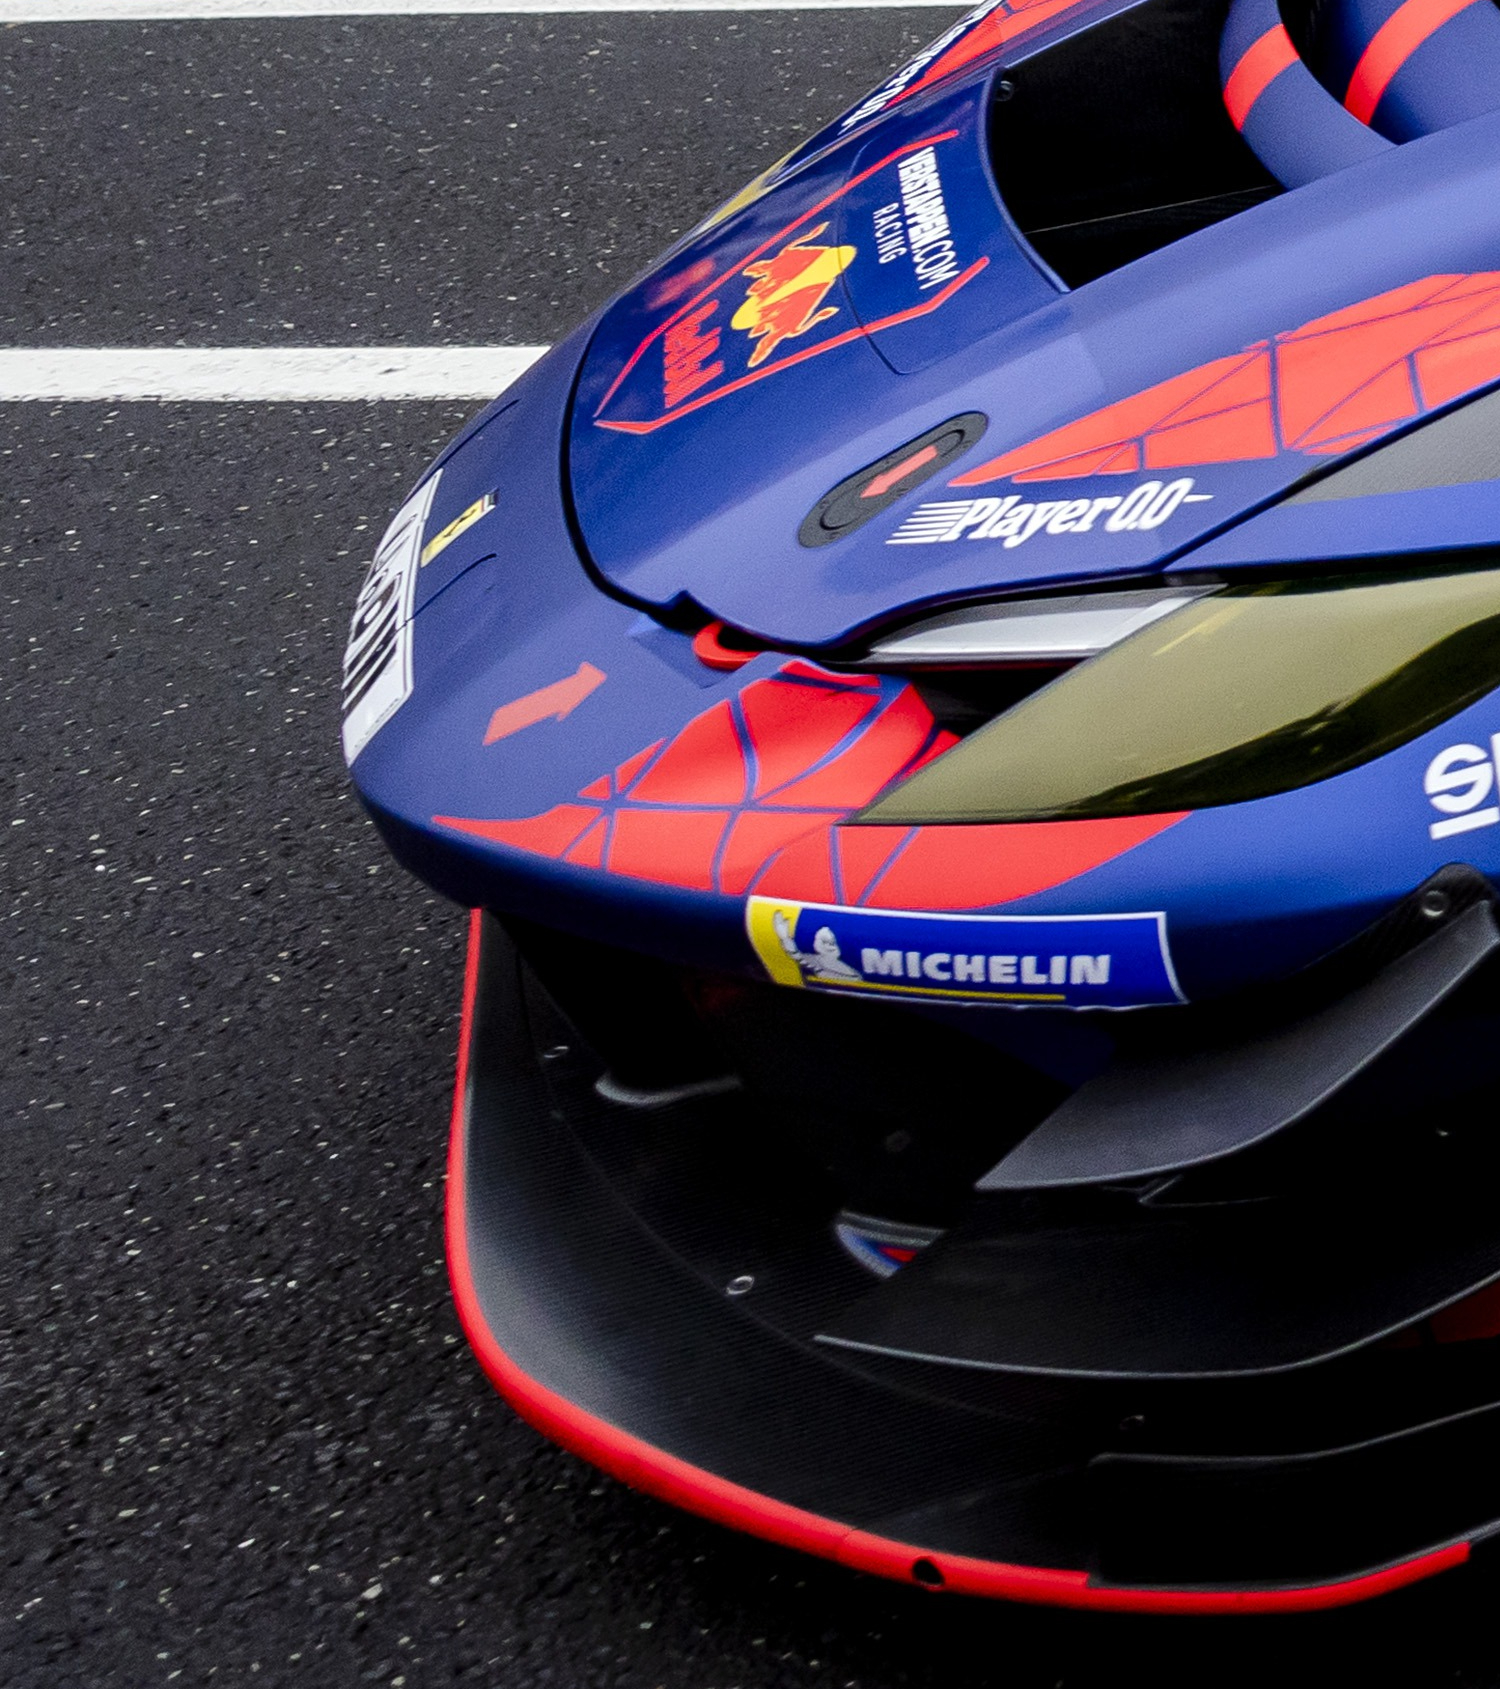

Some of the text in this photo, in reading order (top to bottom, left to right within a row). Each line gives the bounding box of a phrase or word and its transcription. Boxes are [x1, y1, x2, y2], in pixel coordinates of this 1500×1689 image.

[872, 201, 907, 266] RACING
[897, 145, 961, 292] VERSTAPPEN.COM
[937, 494, 1112, 549] Player
[861, 947, 1113, 988] MICHELIN
